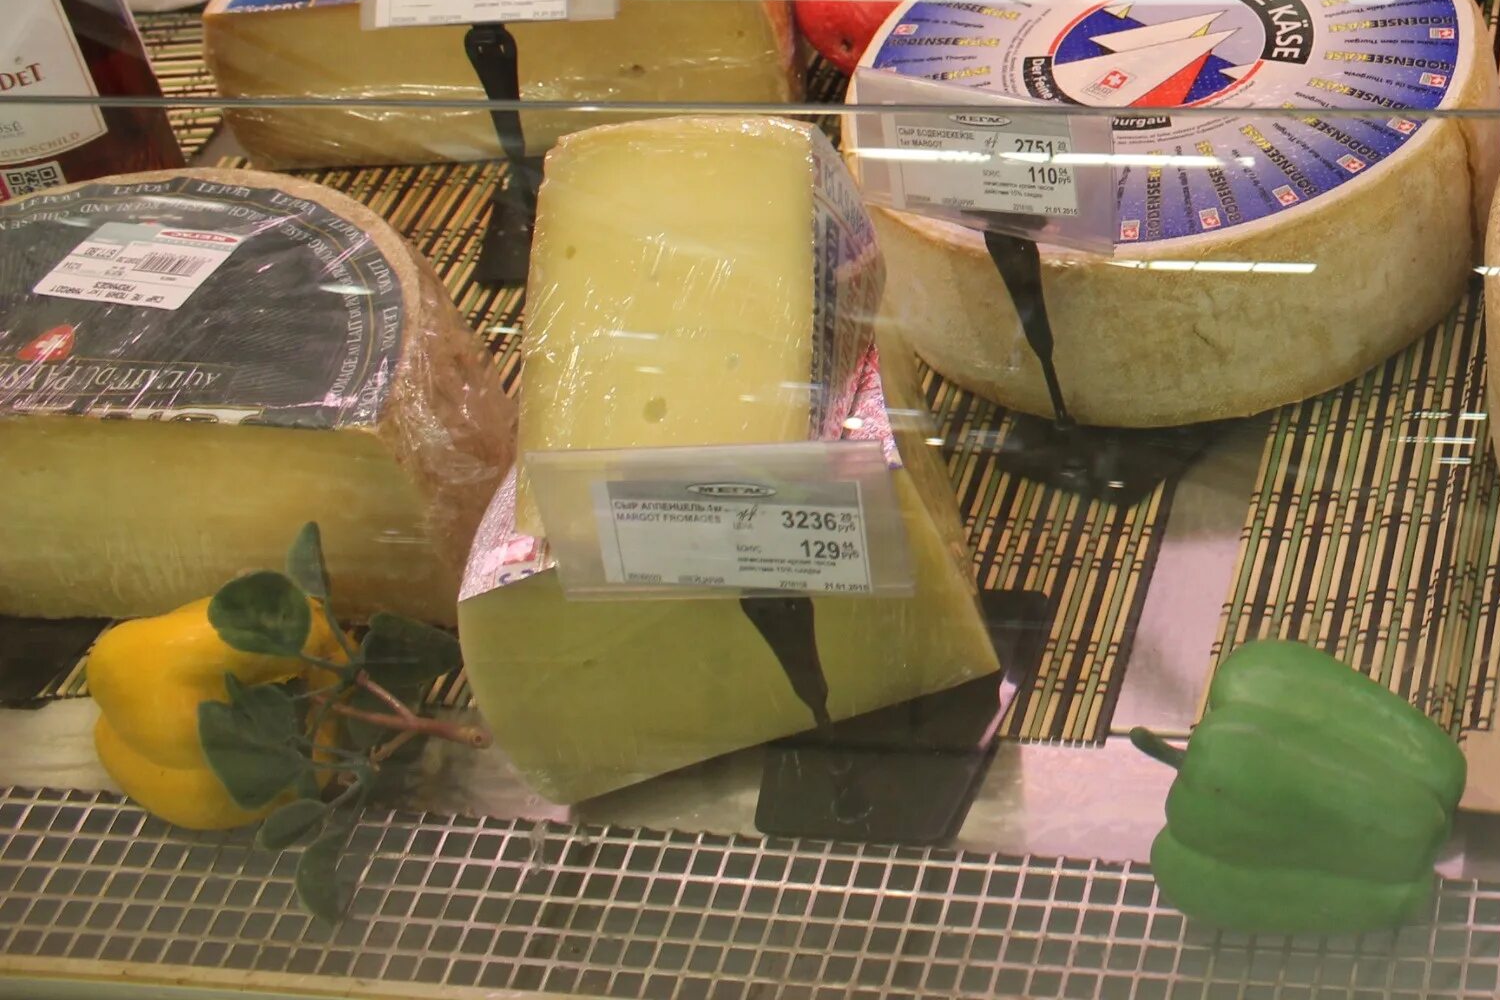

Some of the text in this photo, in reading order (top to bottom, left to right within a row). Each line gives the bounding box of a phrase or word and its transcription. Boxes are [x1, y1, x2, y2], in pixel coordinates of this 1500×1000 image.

[1268, 4, 1310, 58] KÄSE
[955, 114, 1005, 124] МЕГАС
[898, 128, 915, 136] СЫР
[912, 140, 942, 149] MARGOT
[1015, 138, 1053, 157] 2751
[1028, 166, 1057, 184] 110
[1058, 176, 1071, 185] руб
[699, 484, 769, 496] МЕГАС
[614, 501, 638, 510] СЫР
[616, 512, 722, 524] MARGOT FROMAGES
[781, 510, 837, 531] 3236
[838, 522, 856, 532] руб
[800, 539, 840, 560] 129
[841, 550, 860, 560] руб
